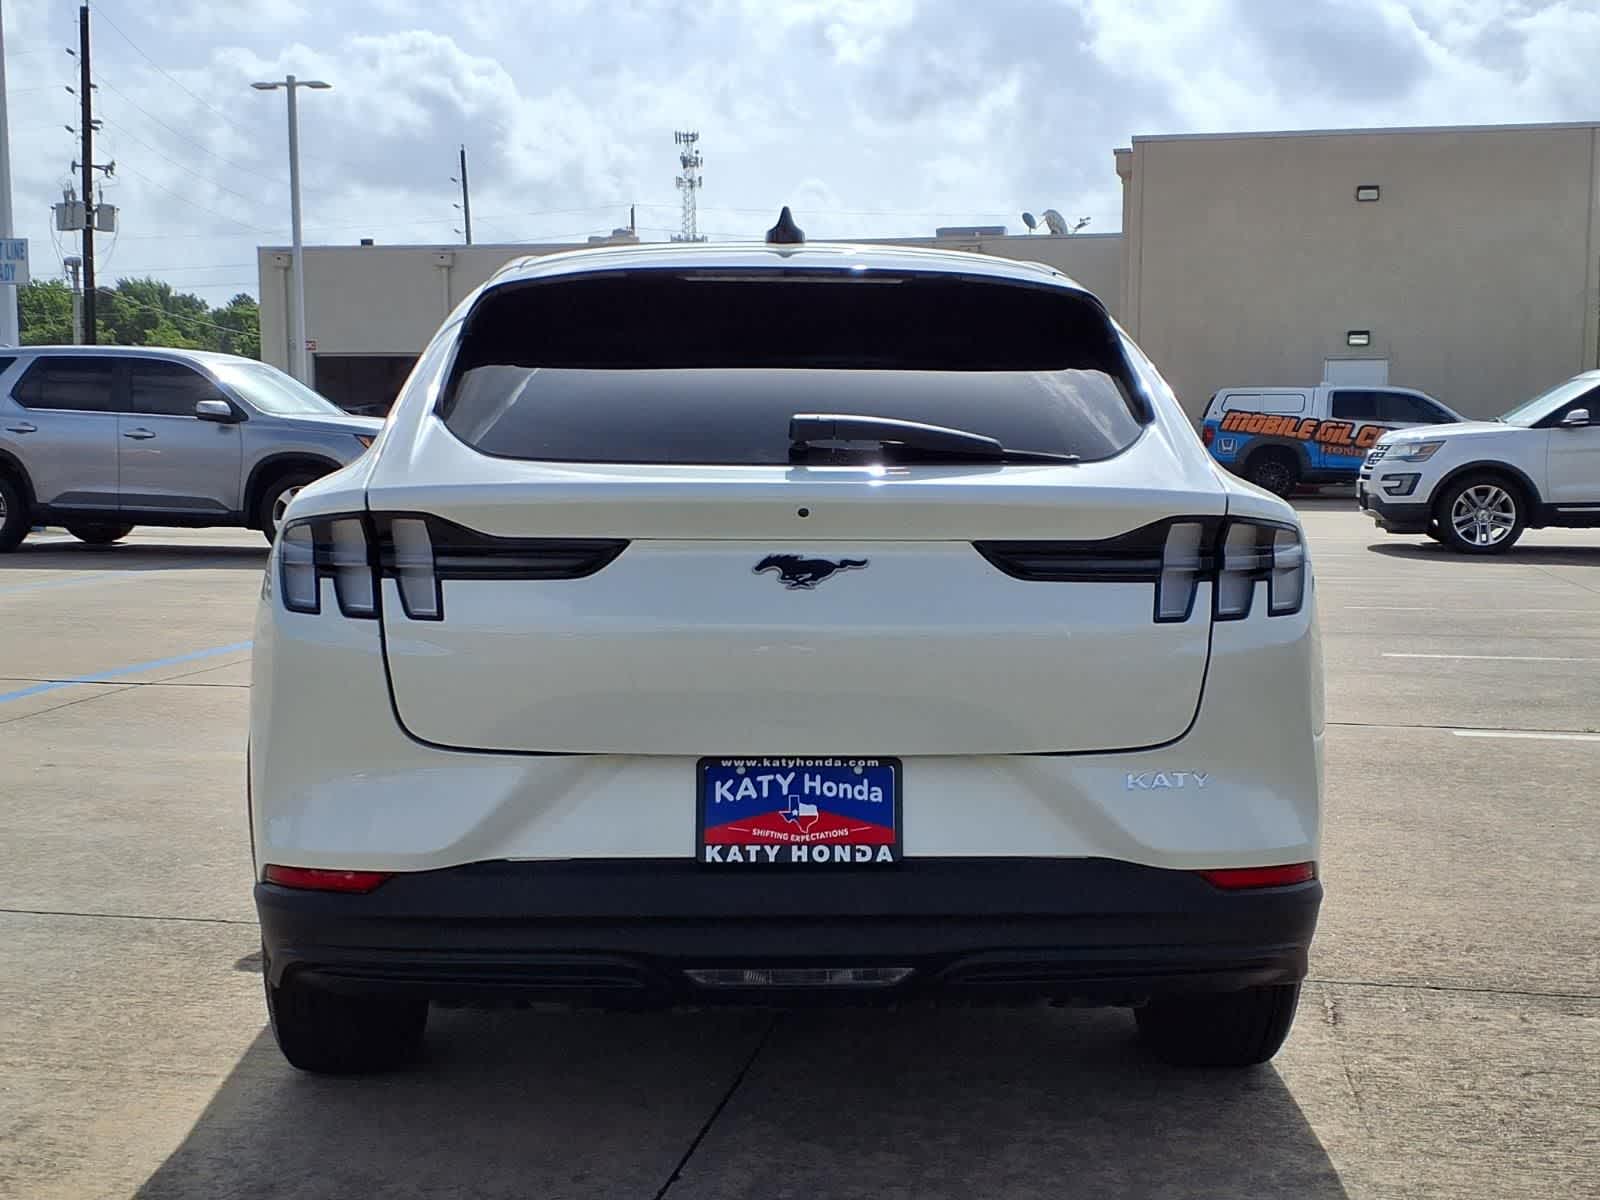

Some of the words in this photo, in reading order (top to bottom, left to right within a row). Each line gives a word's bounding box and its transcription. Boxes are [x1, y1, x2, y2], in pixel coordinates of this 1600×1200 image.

[6, 242, 24, 260] LINE
[1221, 411, 1317, 439] MOBILE
[721, 758, 879, 768] www.katyhonda.com
[715, 772, 796, 803] KATY
[804, 773, 883, 803] Honda
[1126, 772, 1210, 791] KATY
[752, 828, 789, 842] SHIFTING
[790, 828, 849, 843] EXPECTATIONS
[705, 845, 782, 863] KATY
[791, 845, 894, 863] HONDA
